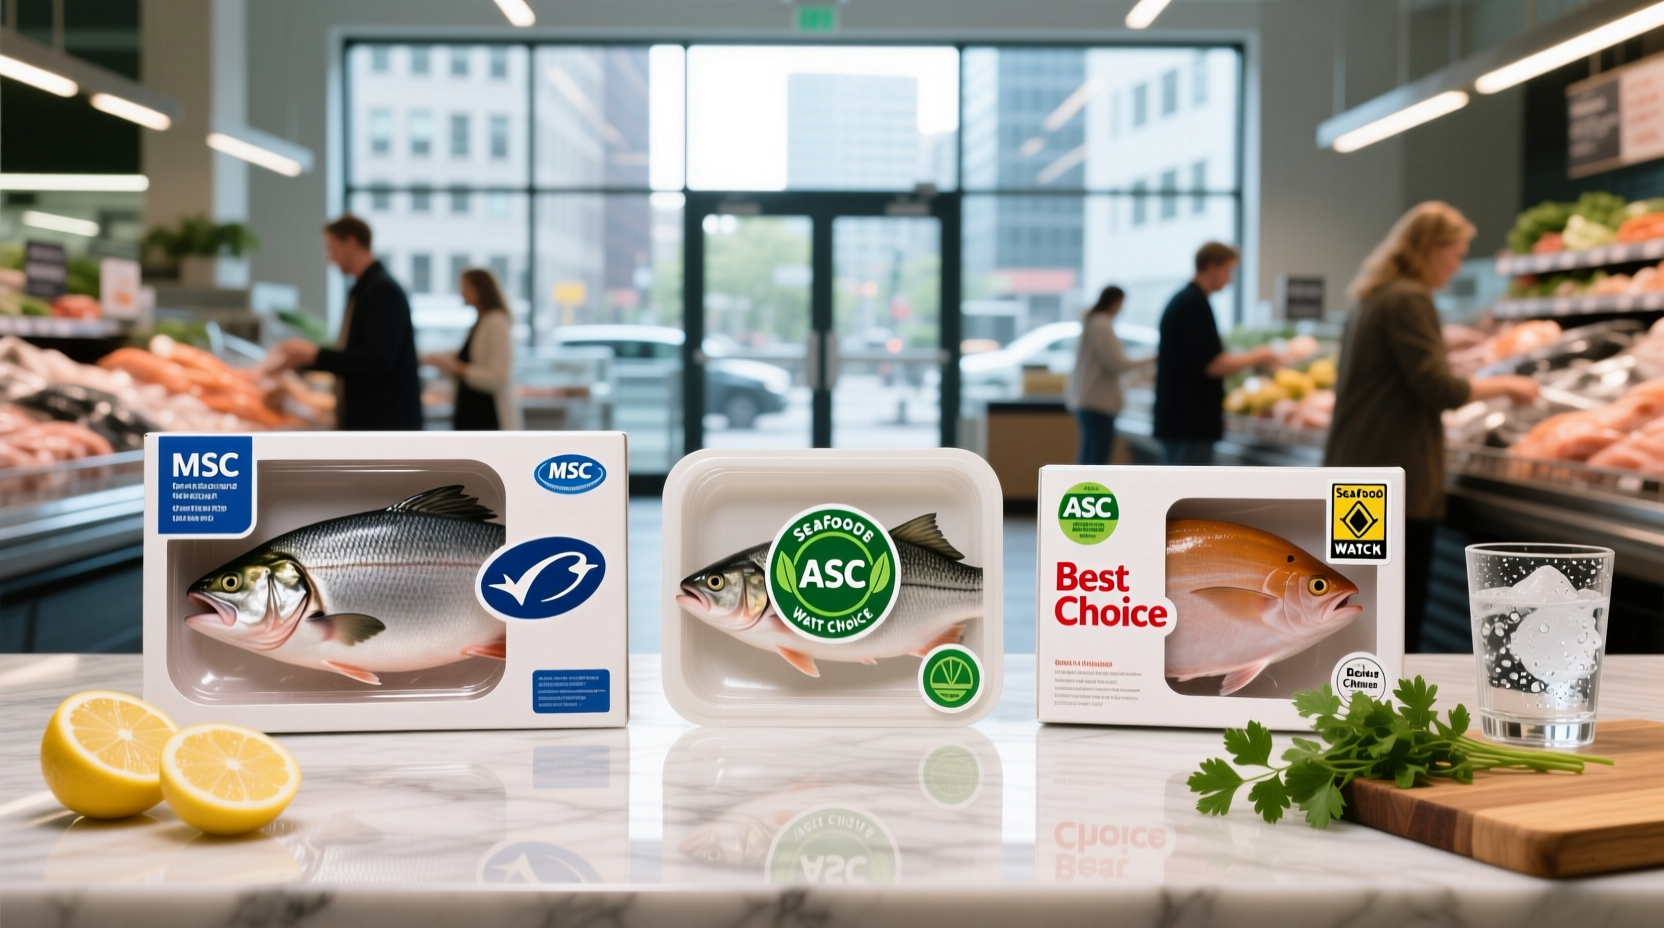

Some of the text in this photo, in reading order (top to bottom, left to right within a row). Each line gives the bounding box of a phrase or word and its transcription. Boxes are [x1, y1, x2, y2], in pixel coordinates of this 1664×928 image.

[172, 452, 239, 478] MSC
[548, 462, 593, 480] MSC
[1062, 496, 1112, 518] ASC
[798, 559, 866, 589] ASC
[1056, 562, 1130, 592] Best
[1054, 596, 1168, 628] Choice
